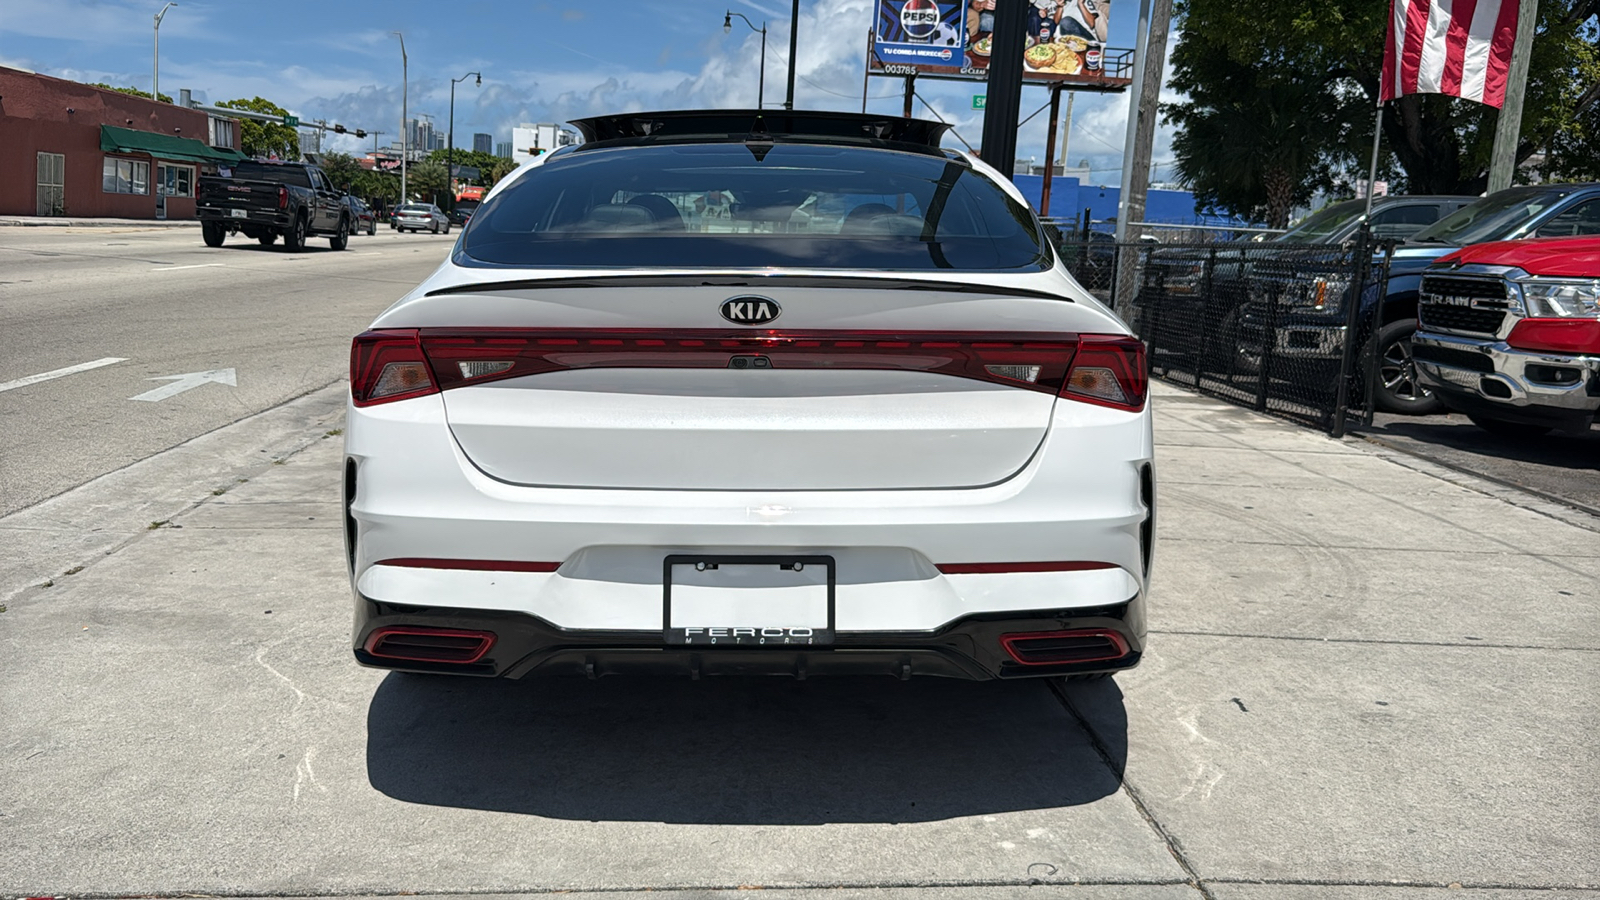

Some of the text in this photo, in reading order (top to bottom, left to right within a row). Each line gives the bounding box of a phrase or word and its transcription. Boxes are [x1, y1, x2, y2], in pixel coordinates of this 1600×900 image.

[903, 12, 938, 22] PEPSI
[893, 48, 917, 56] COMIDA
[885, 64, 916, 75] 003785
[227, 185, 252, 193] GMC
[1433, 294, 1470, 307] RAM
[729, 302, 772, 319] KIA
[685, 626, 813, 637] FERCO
